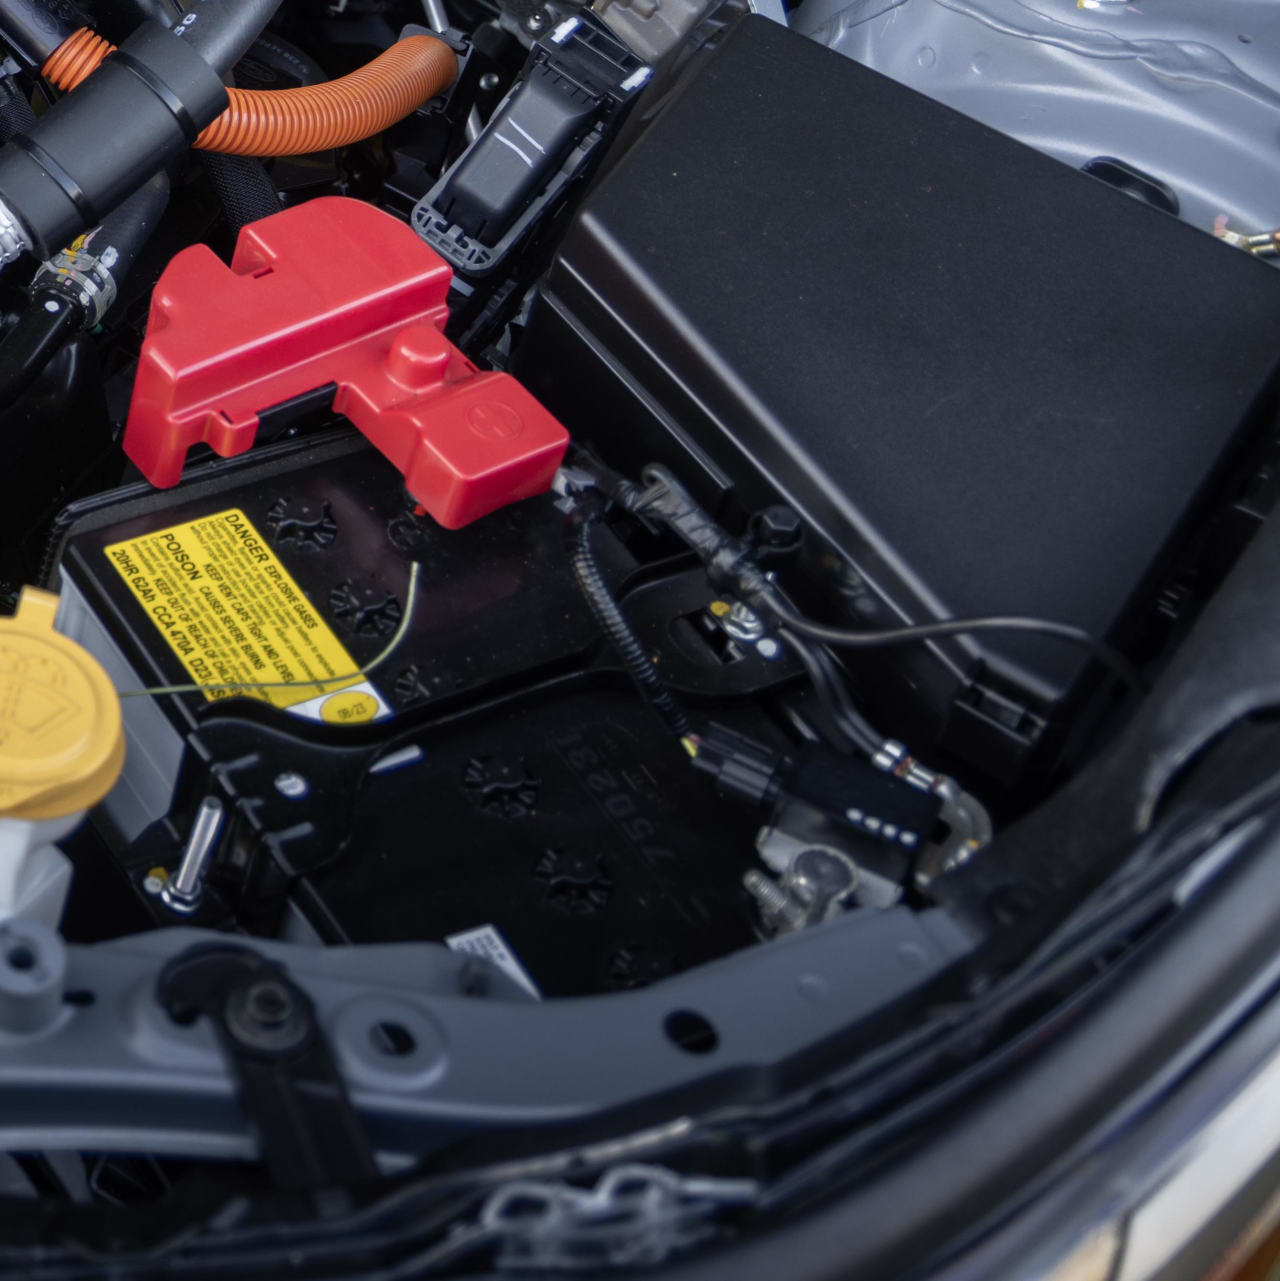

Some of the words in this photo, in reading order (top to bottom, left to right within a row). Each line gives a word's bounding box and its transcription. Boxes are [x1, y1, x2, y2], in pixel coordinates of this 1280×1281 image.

[223, 512, 271, 564] DANGER
[262, 564, 300, 604] EXPLOSIVE
[291, 602, 319, 630] GASES
[151, 576, 175, 598] KEEP
[109, 548, 141, 577] 20HR
[128, 575, 159, 603] 62Ah
[150, 604, 179, 630] CCA
[167, 627, 197, 655] 470A
[158, 532, 204, 581] POISON
[197, 585, 227, 615] CAUSES
[218, 614, 247, 643] SEVERE
[239, 643, 267, 670] BURNS
[165, 596, 186, 614] OUT
[200, 562, 224, 583] KEEP
[215, 581, 238, 601] VENT
[229, 601, 253, 622] CAPS
[243, 620, 269, 644] TIGHT
[259, 642, 281, 661] AND
[176, 611, 194, 624] OF
[184, 623, 212, 650] REACH
[203, 648, 219, 660] OF
